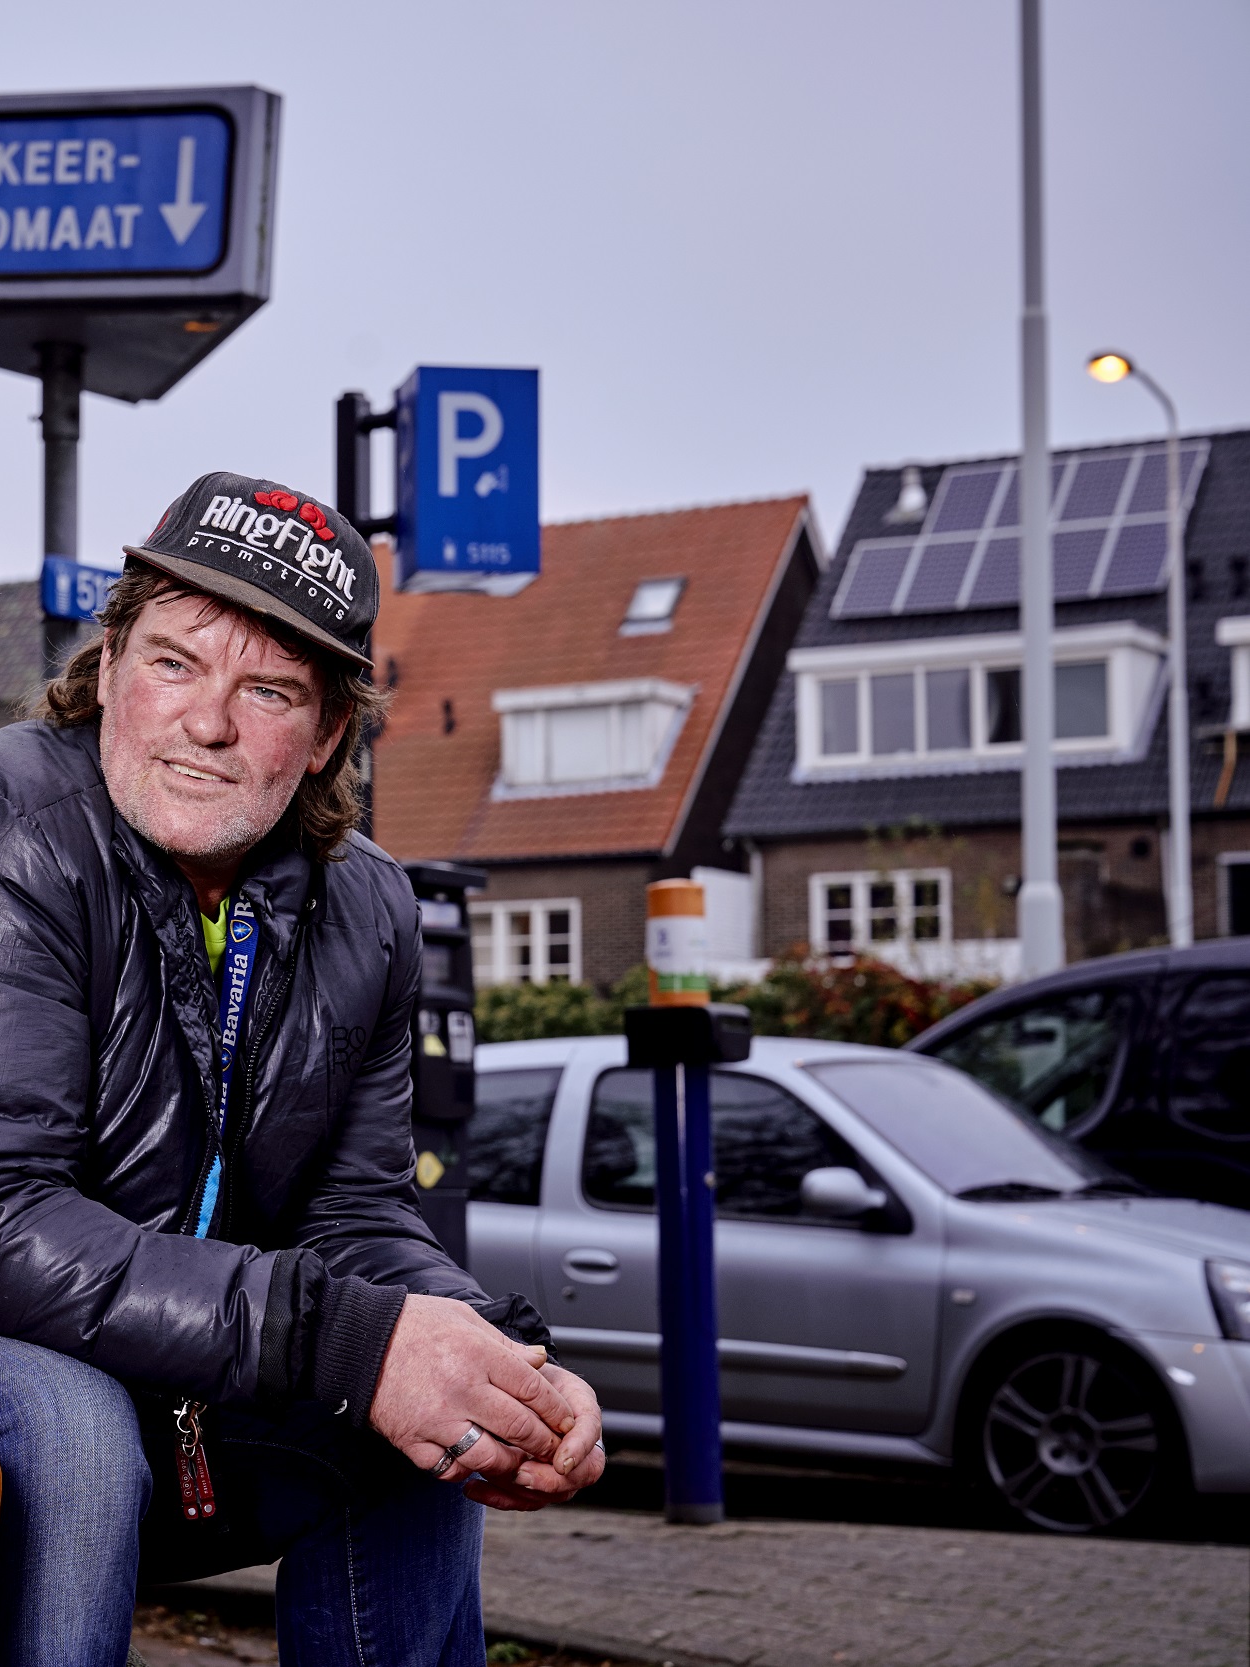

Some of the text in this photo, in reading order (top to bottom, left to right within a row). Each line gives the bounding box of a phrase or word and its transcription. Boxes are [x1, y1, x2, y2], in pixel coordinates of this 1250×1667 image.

[438, 391, 504, 498] P
[187, 535, 345, 621] promotions
[222, 953, 249, 1047] Bavaria
